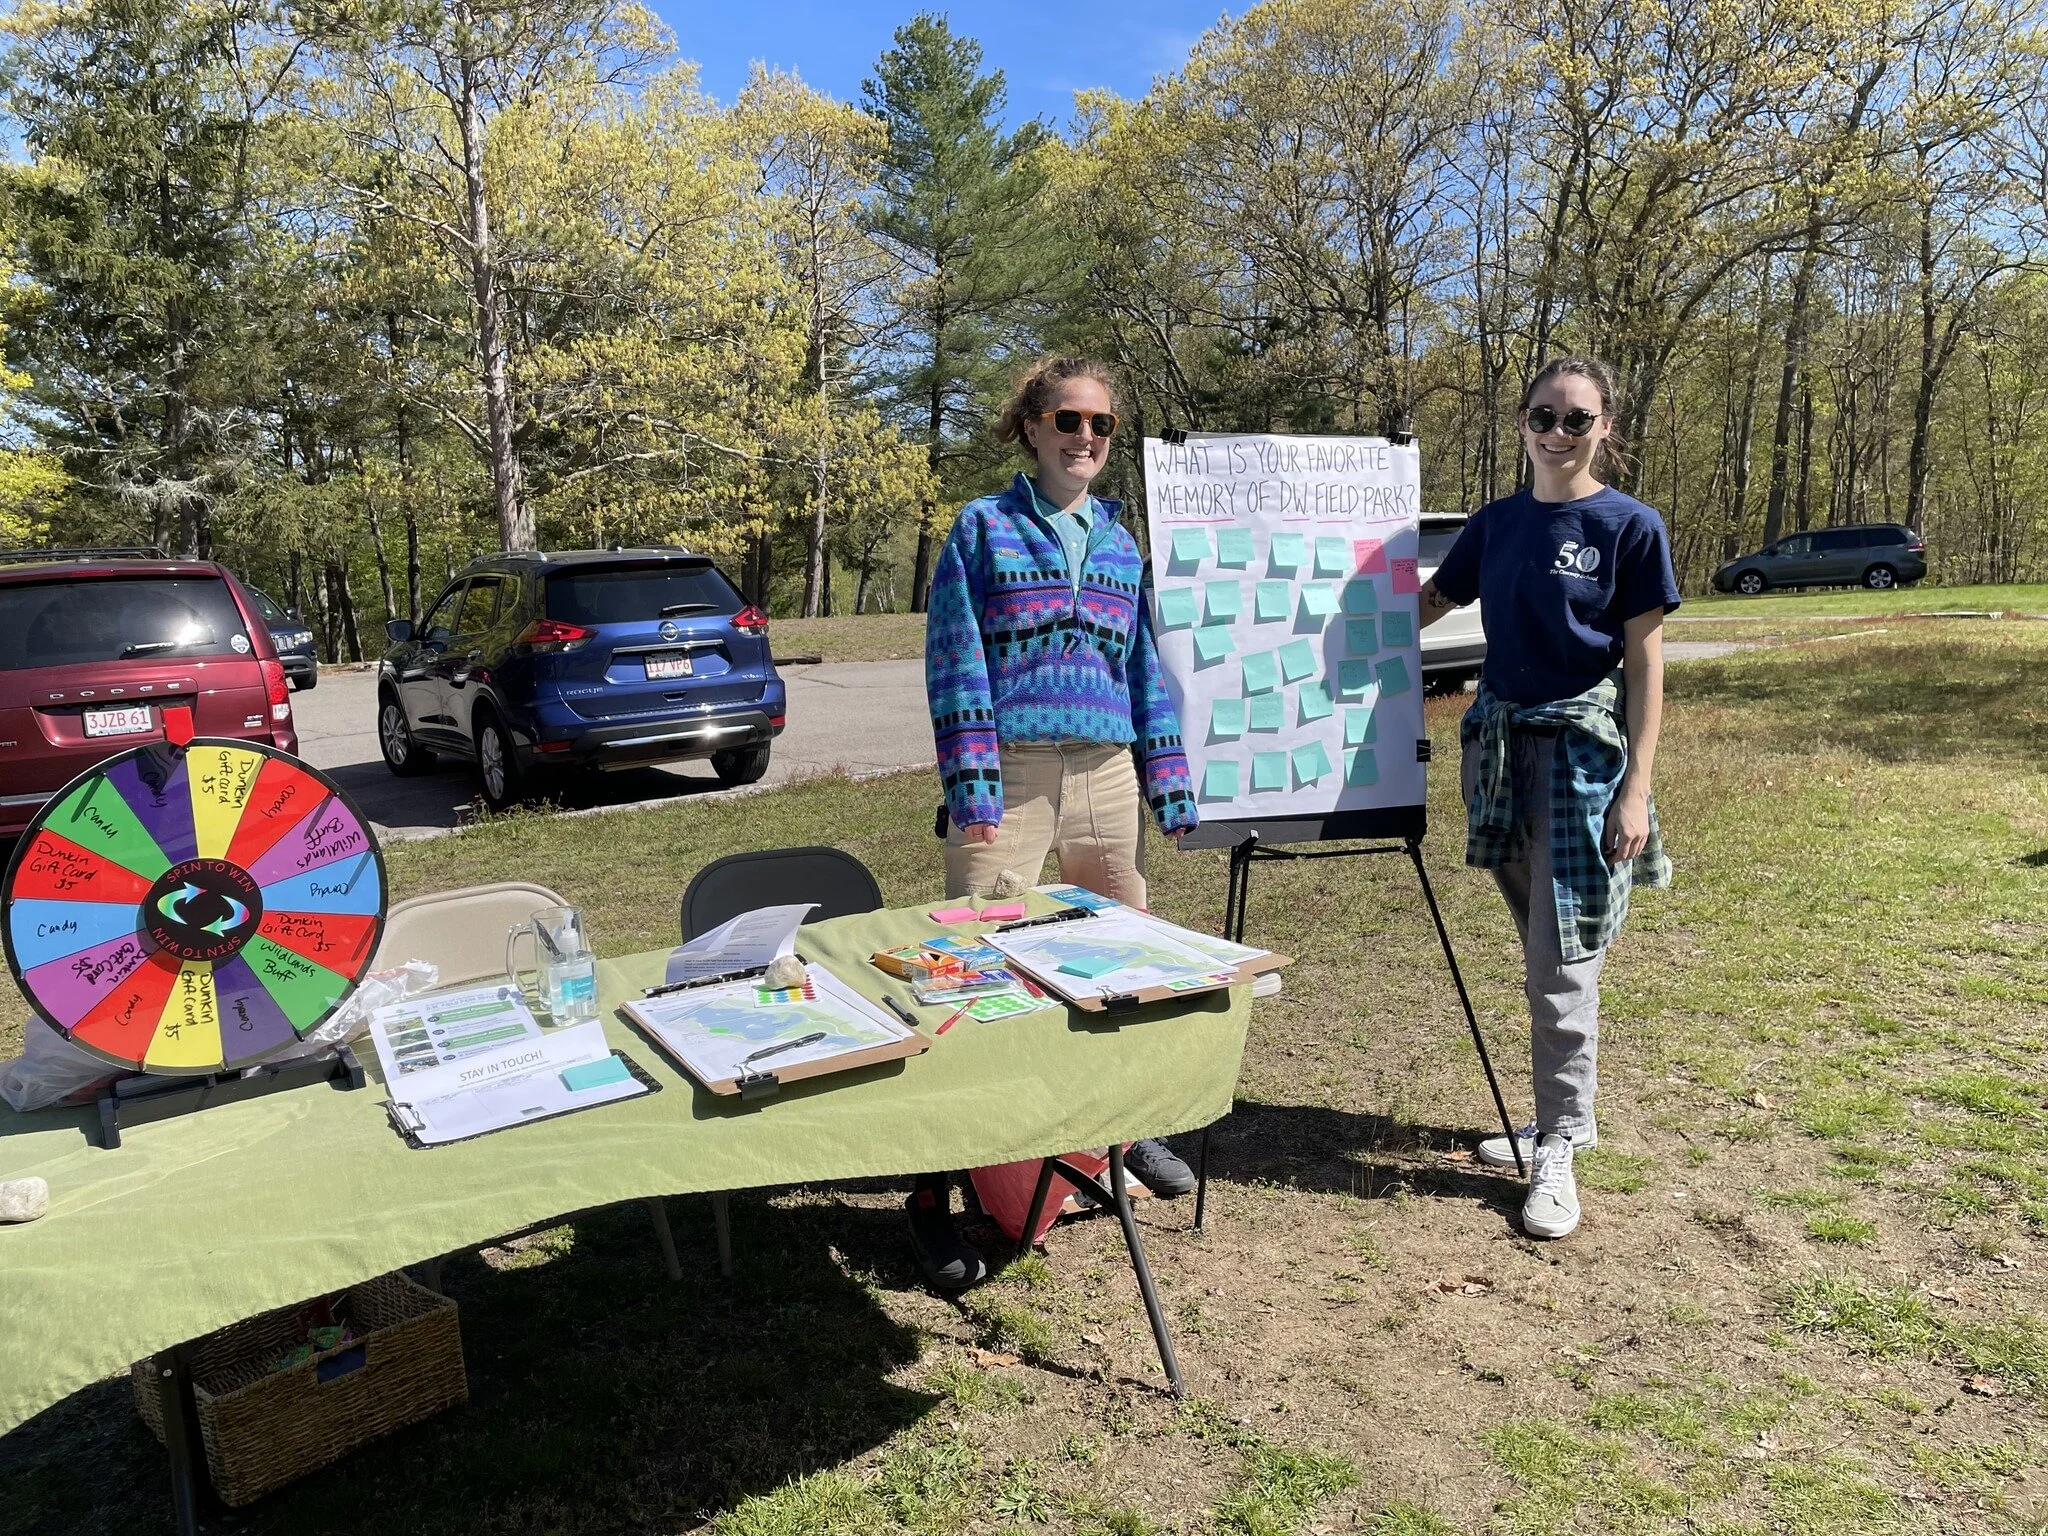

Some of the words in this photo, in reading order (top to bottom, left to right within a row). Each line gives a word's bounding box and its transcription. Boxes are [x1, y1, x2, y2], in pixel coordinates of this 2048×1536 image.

[1153, 445, 1213, 475] WHAT
[1227, 444, 1246, 475] IS
[1253, 442, 1302, 474] YOUR
[1306, 443, 1391, 473] FAVORITE
[1158, 482, 1236, 515] MEMORY
[1247, 480, 1270, 513] OF
[1316, 482, 1359, 515] FIELD
[1363, 484, 1415, 517] PARK?
[1554, 543, 1601, 573] 50
[670, 659, 690, 672] VP6
[50, 682, 180, 701] DODGE
[566, 687, 604, 696] ROGUE
[87, 712, 126, 729] 3JZB
[130, 710, 149, 725] 61
[218, 750, 233, 777] Gift
[201, 775, 216, 795] $5
[231, 758, 254, 809] Dunkin
[83, 806, 118, 839] Candy
[303, 817, 345, 850] Buff
[37, 840, 89, 865] Dunkin
[296, 831, 361, 869] Wildlands
[29, 857, 60, 873] Gift
[62, 862, 98, 881] Card
[166, 861, 201, 883] SPIN
[206, 861, 225, 872] TO
[228, 867, 255, 893] WIN
[54, 879, 78, 891] $5
[37, 919, 77, 937] Candy
[262, 923, 294, 937] Gift
[295, 926, 325, 941] Card
[276, 913, 323, 928] Dunkin
[152, 927, 180, 951] WIN
[206, 936, 241, 958] SPIN
[313, 941, 336, 952] $5
[182, 947, 202, 959] TO
[260, 941, 316, 978] Wildlands
[71, 956, 93, 979] $5
[86, 961, 114, 985] Card
[106, 948, 150, 983] Dunkin
[262, 959, 297, 982] Buff
[181, 970, 197, 996] Gift
[114, 993, 143, 1026] Candy
[200, 970, 214, 1025] Dunkin
[164, 1022, 182, 1041] $5
[459, 1067, 484, 1082] STAY
[487, 1063, 499, 1074] IN
[501, 1049, 543, 1069] TOUCH!
